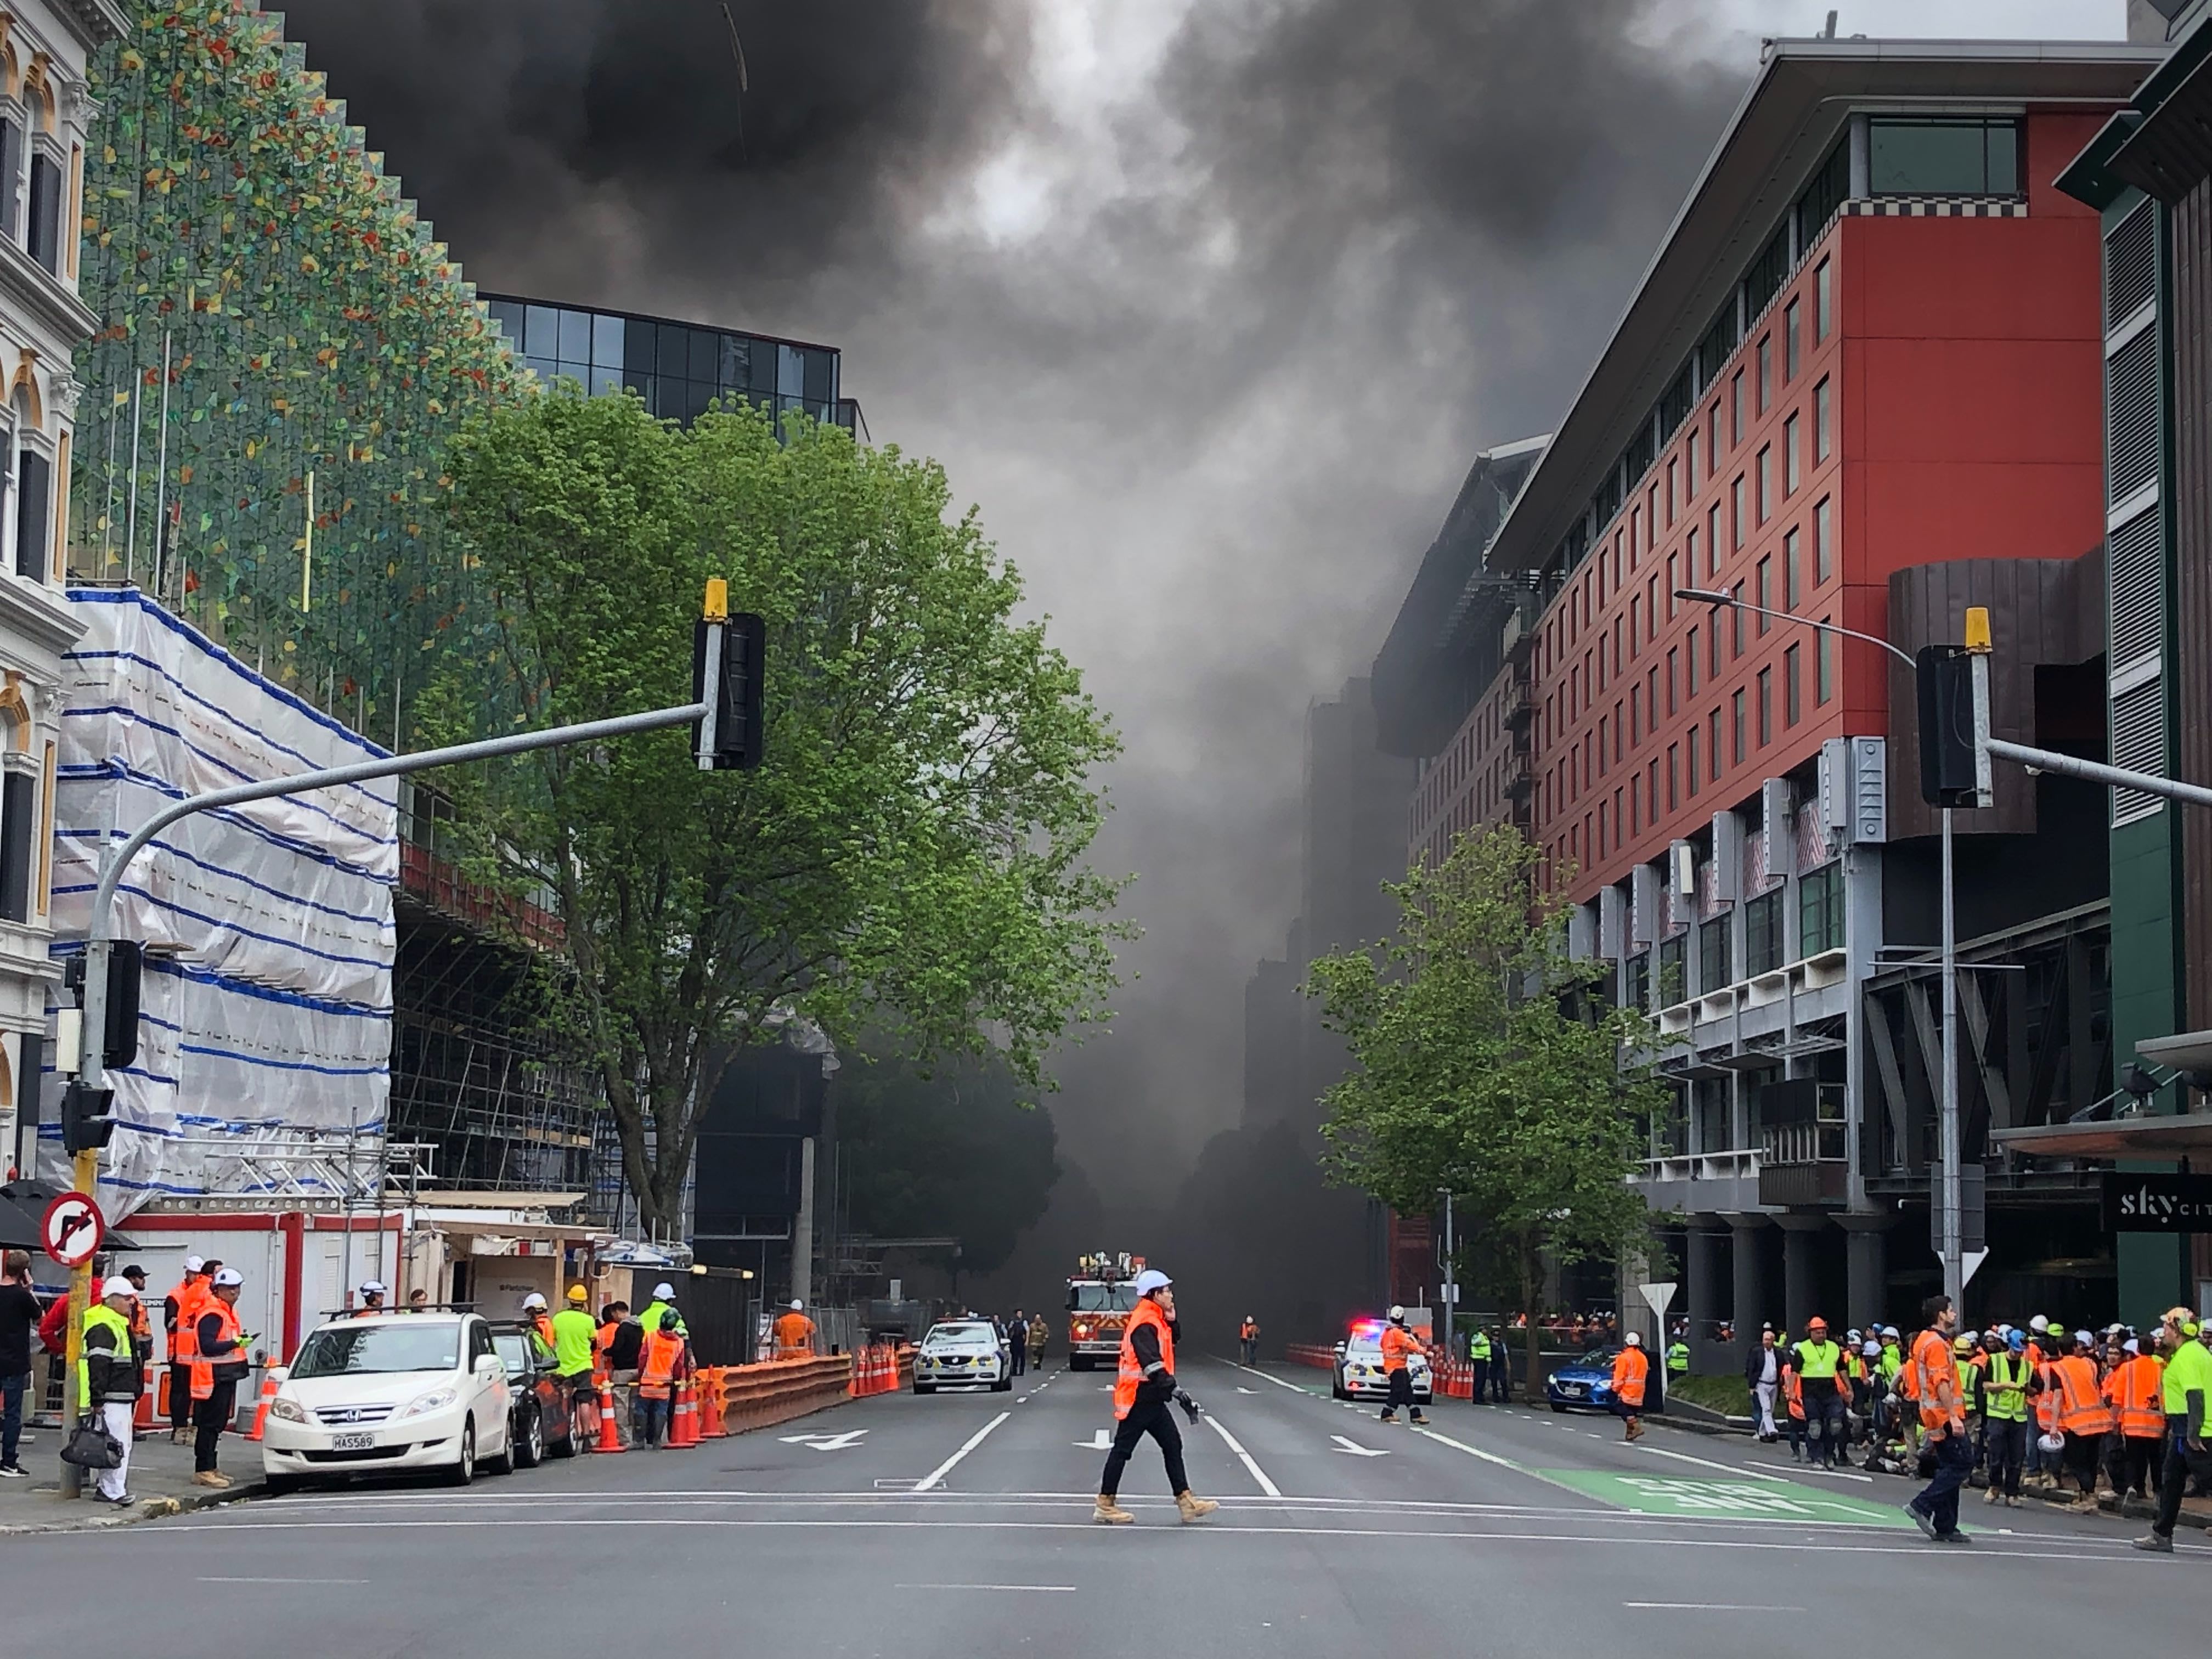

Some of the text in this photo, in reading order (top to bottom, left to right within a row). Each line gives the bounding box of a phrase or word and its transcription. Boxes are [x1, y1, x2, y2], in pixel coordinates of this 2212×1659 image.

[335, 1437, 373, 1449] HAS589
[1615, 1477, 1788, 1498] BUS
[1638, 1492, 1888, 1519] LANE
